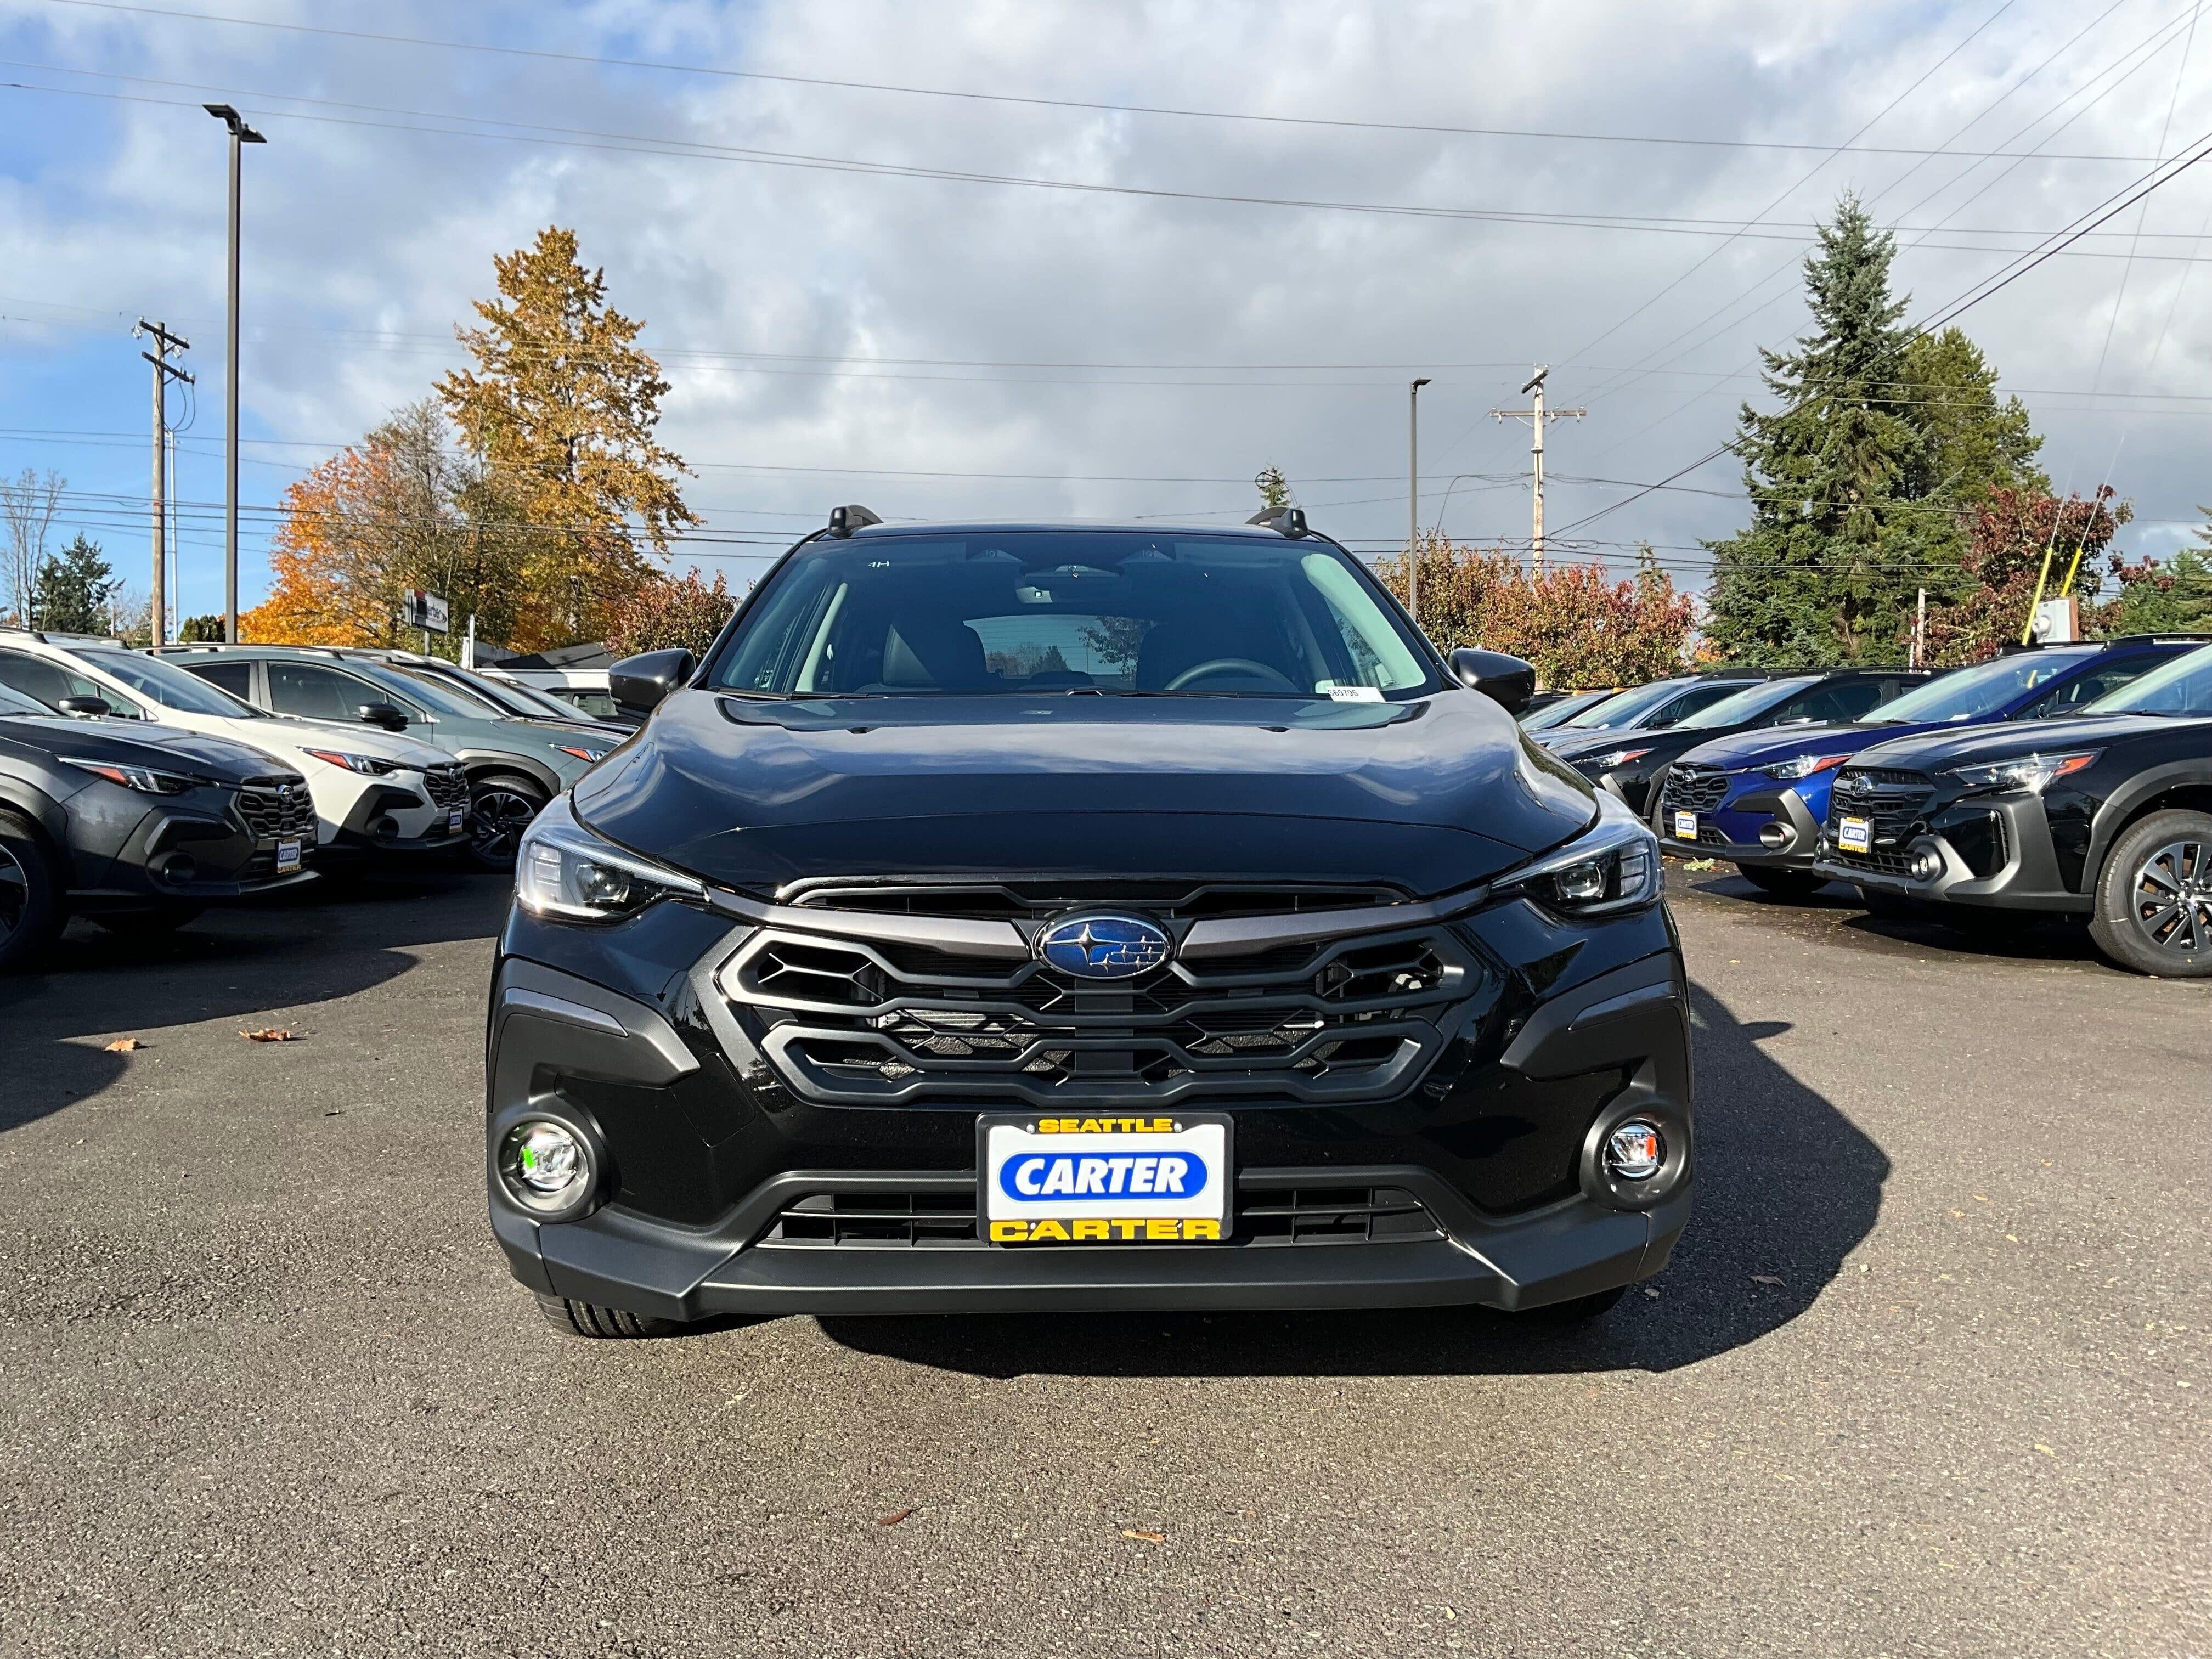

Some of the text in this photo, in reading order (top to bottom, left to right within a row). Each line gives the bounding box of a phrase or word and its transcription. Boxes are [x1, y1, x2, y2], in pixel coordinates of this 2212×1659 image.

[1844, 827, 1865, 840] CARTER
[1839, 843, 1867, 853] CARTER
[1039, 1118, 1172, 1133] SEATTLE
[1015, 1158, 1189, 1195] CARTER
[990, 1220, 1221, 1242] CARTER
